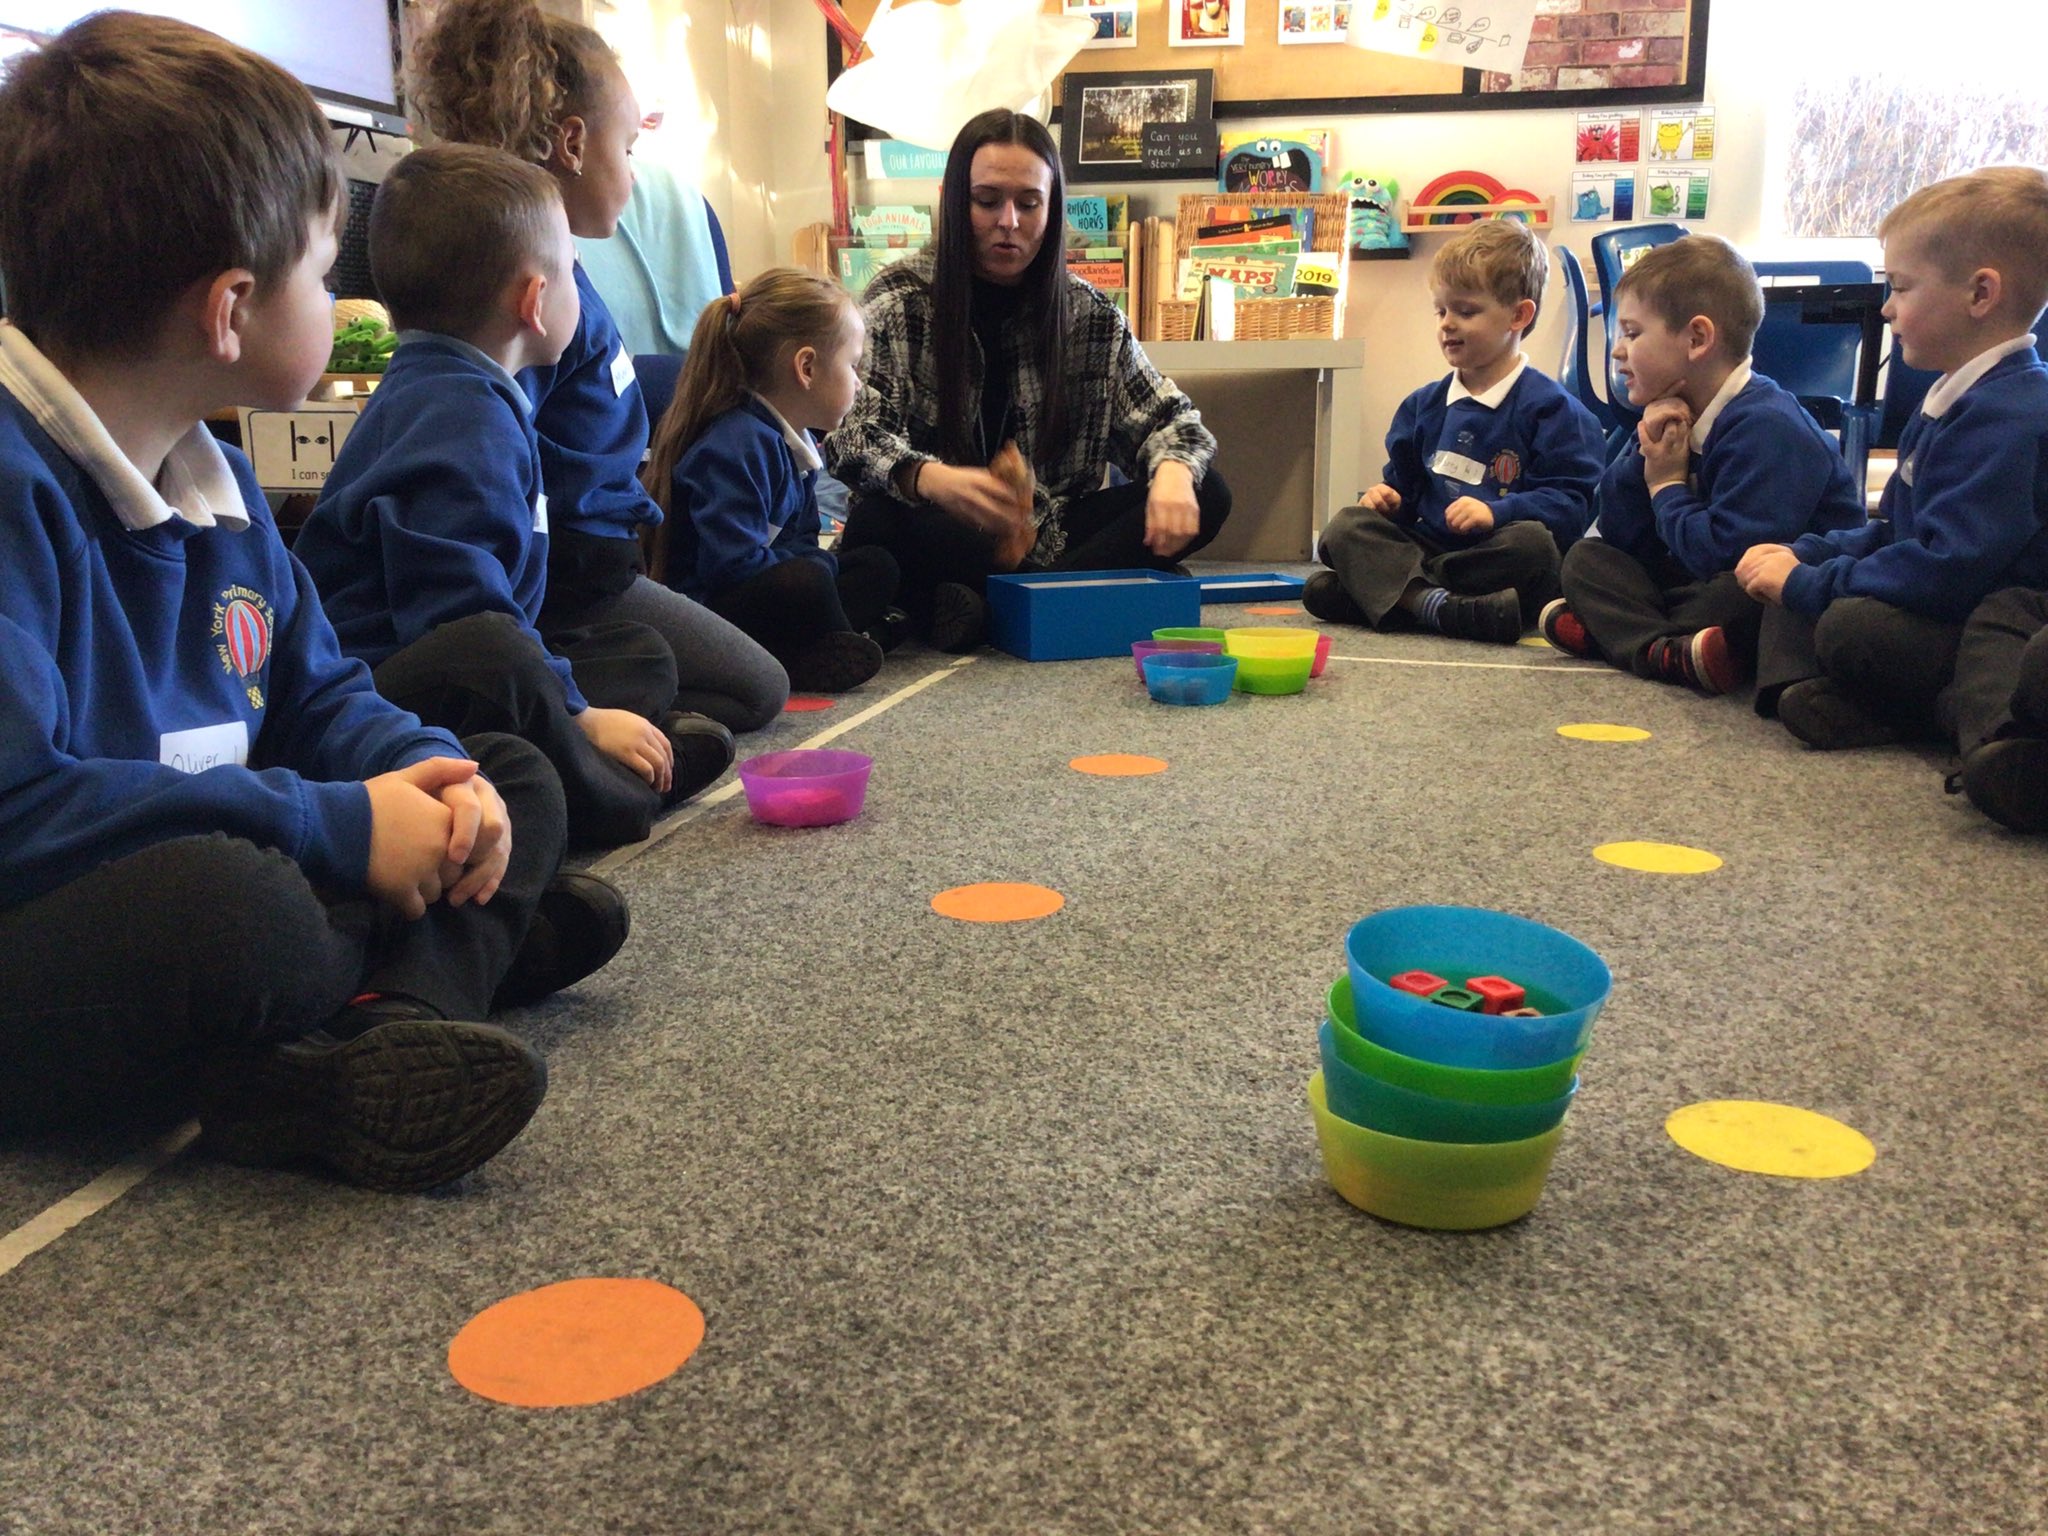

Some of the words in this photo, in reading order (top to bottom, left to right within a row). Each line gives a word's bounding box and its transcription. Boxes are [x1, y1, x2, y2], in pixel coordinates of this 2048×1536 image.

[1150, 130, 1170, 142] Can
[1178, 132, 1198, 147] you
[1147, 145, 1171, 156] read
[1178, 147, 1191, 156] us
[1195, 147, 1202, 155] a
[889, 153, 908, 171] OUR
[1248, 169, 1288, 188] WORRY
[1295, 268, 1332, 284] 2019
[291, 468, 296, 480] I
[299, 471, 318, 480] can
[209, 602, 226, 639] York
[221, 584, 267, 610] Primary
